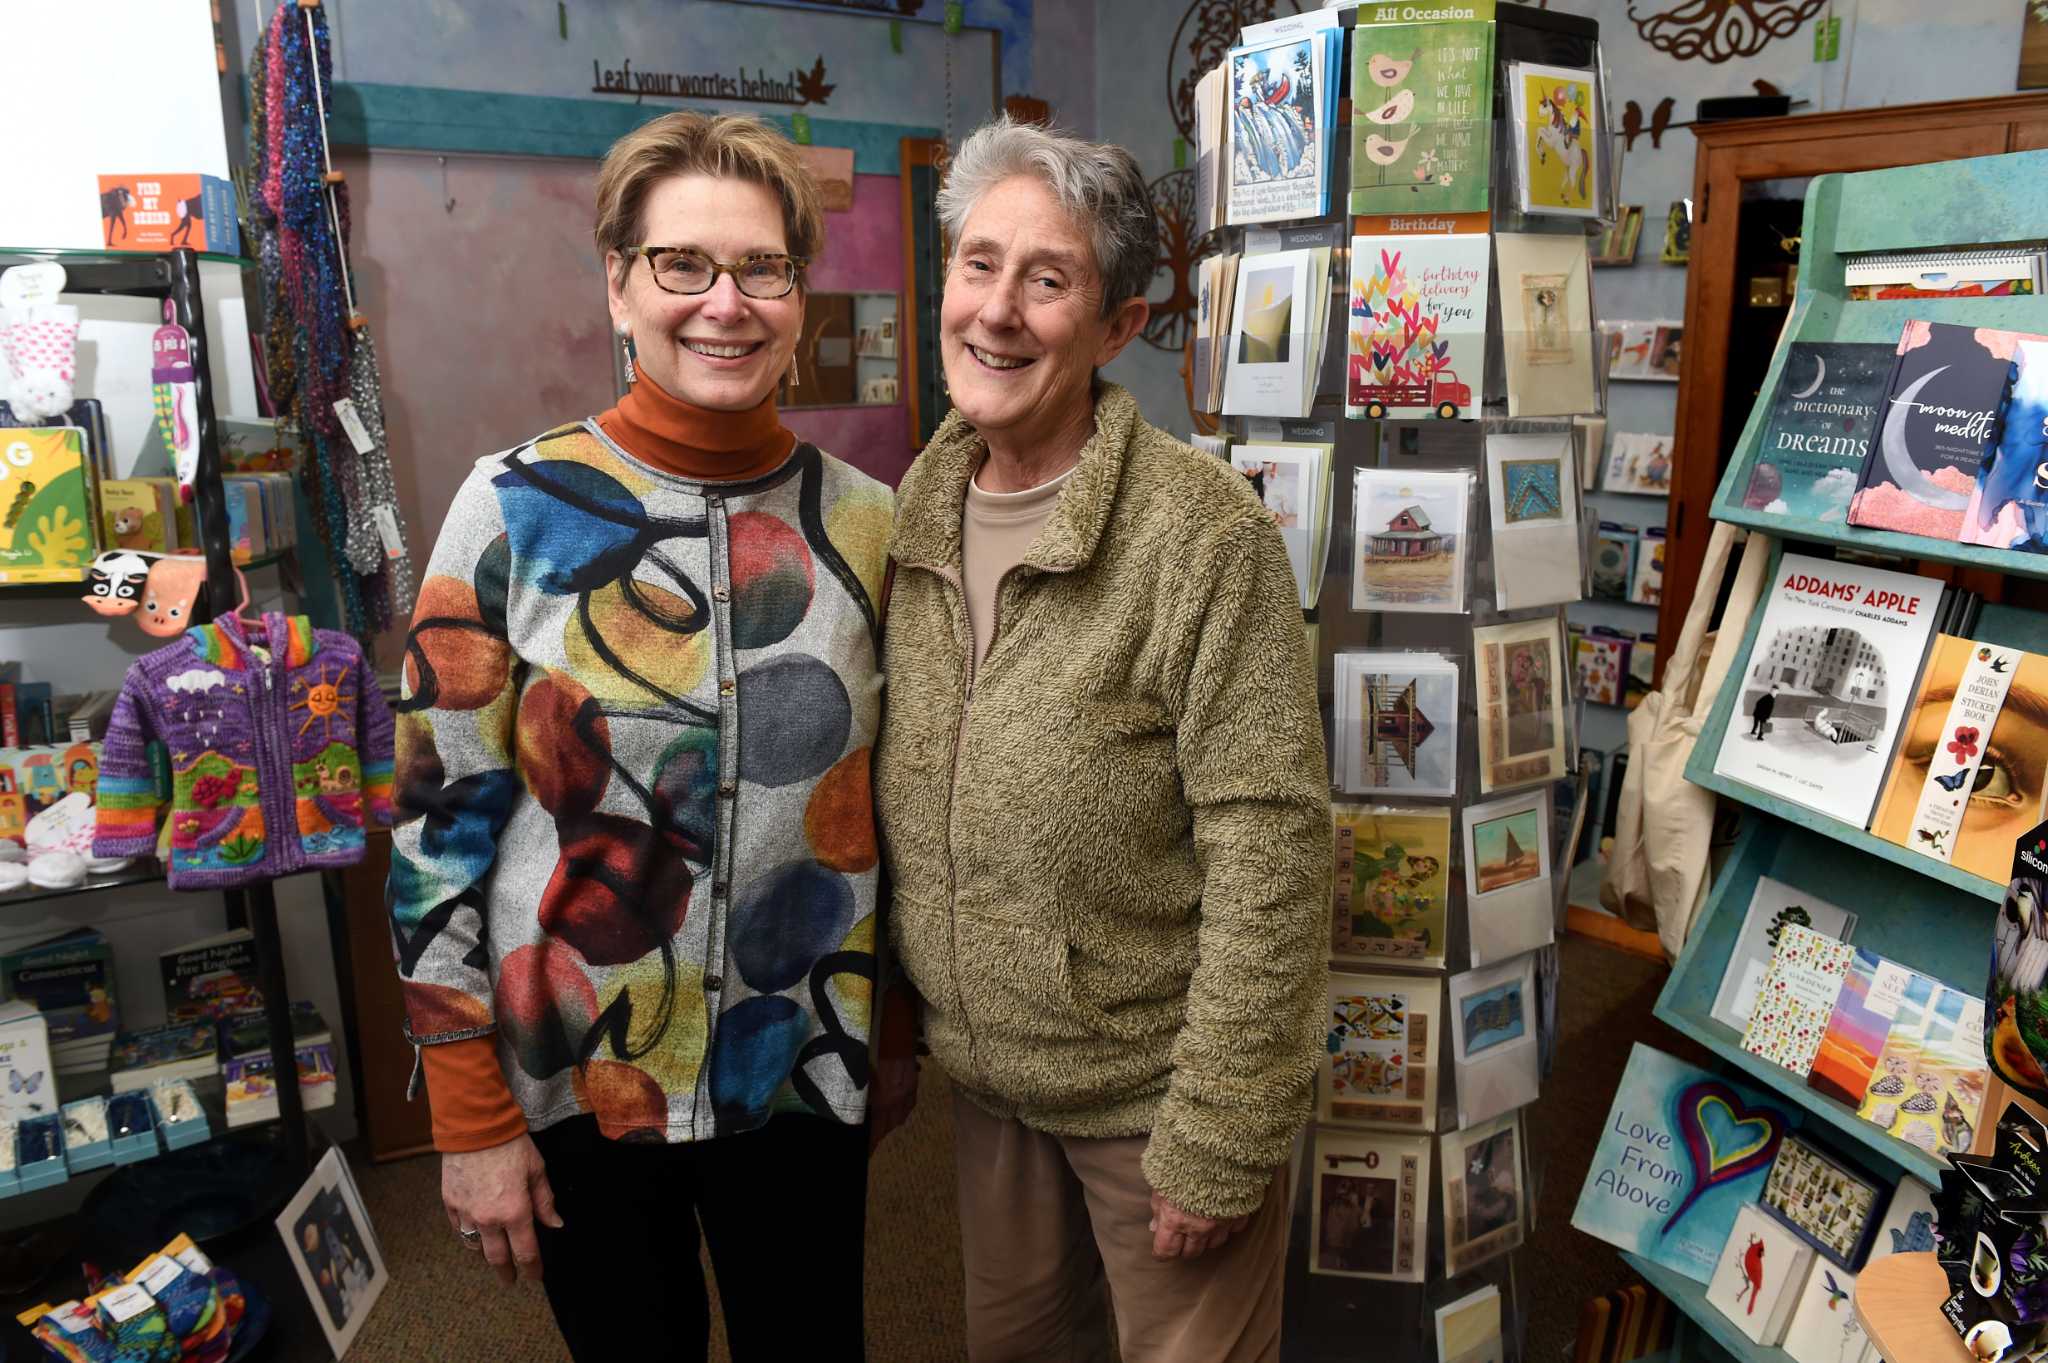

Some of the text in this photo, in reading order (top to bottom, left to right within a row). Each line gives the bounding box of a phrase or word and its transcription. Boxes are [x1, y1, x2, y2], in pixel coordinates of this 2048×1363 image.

[1375, 6, 1475, 21] All Occasion
[1274, 22, 1304, 33] WEDDING
[593, 59, 795, 105] Leaf your worries behind
[136, 182, 161, 196] FIND
[142, 197, 158, 210] MY
[133, 211, 170, 224] BEHIND
[1389, 217, 1456, 235] Birthday
[1289, 231, 1324, 243] WEDDING
[1424, 265, 1480, 282] birthday
[1421, 281, 1471, 298] delivery
[1427, 297, 1473, 323] for you
[1291, 427, 1324, 438] WEDDING
[1784, 573, 1920, 615] ADDAMS' APPLE
[1855, 609, 1881, 621] CHARLES
[1882, 616, 1908, 627] ADDAMS
[1976, 674, 2000, 688] JOHN
[1968, 683, 2000, 699] DERIAN
[1960, 696, 1996, 713] STICKER
[1963, 708, 1987, 723] BOOK
[1336, 828, 1353, 951] BIRTHDAY
[1614, 1111, 1673, 1151] Love
[1620, 1145, 1684, 1188] From
[1594, 1168, 1672, 1215] Above
[1399, 1159, 1417, 1270] WEDDING
